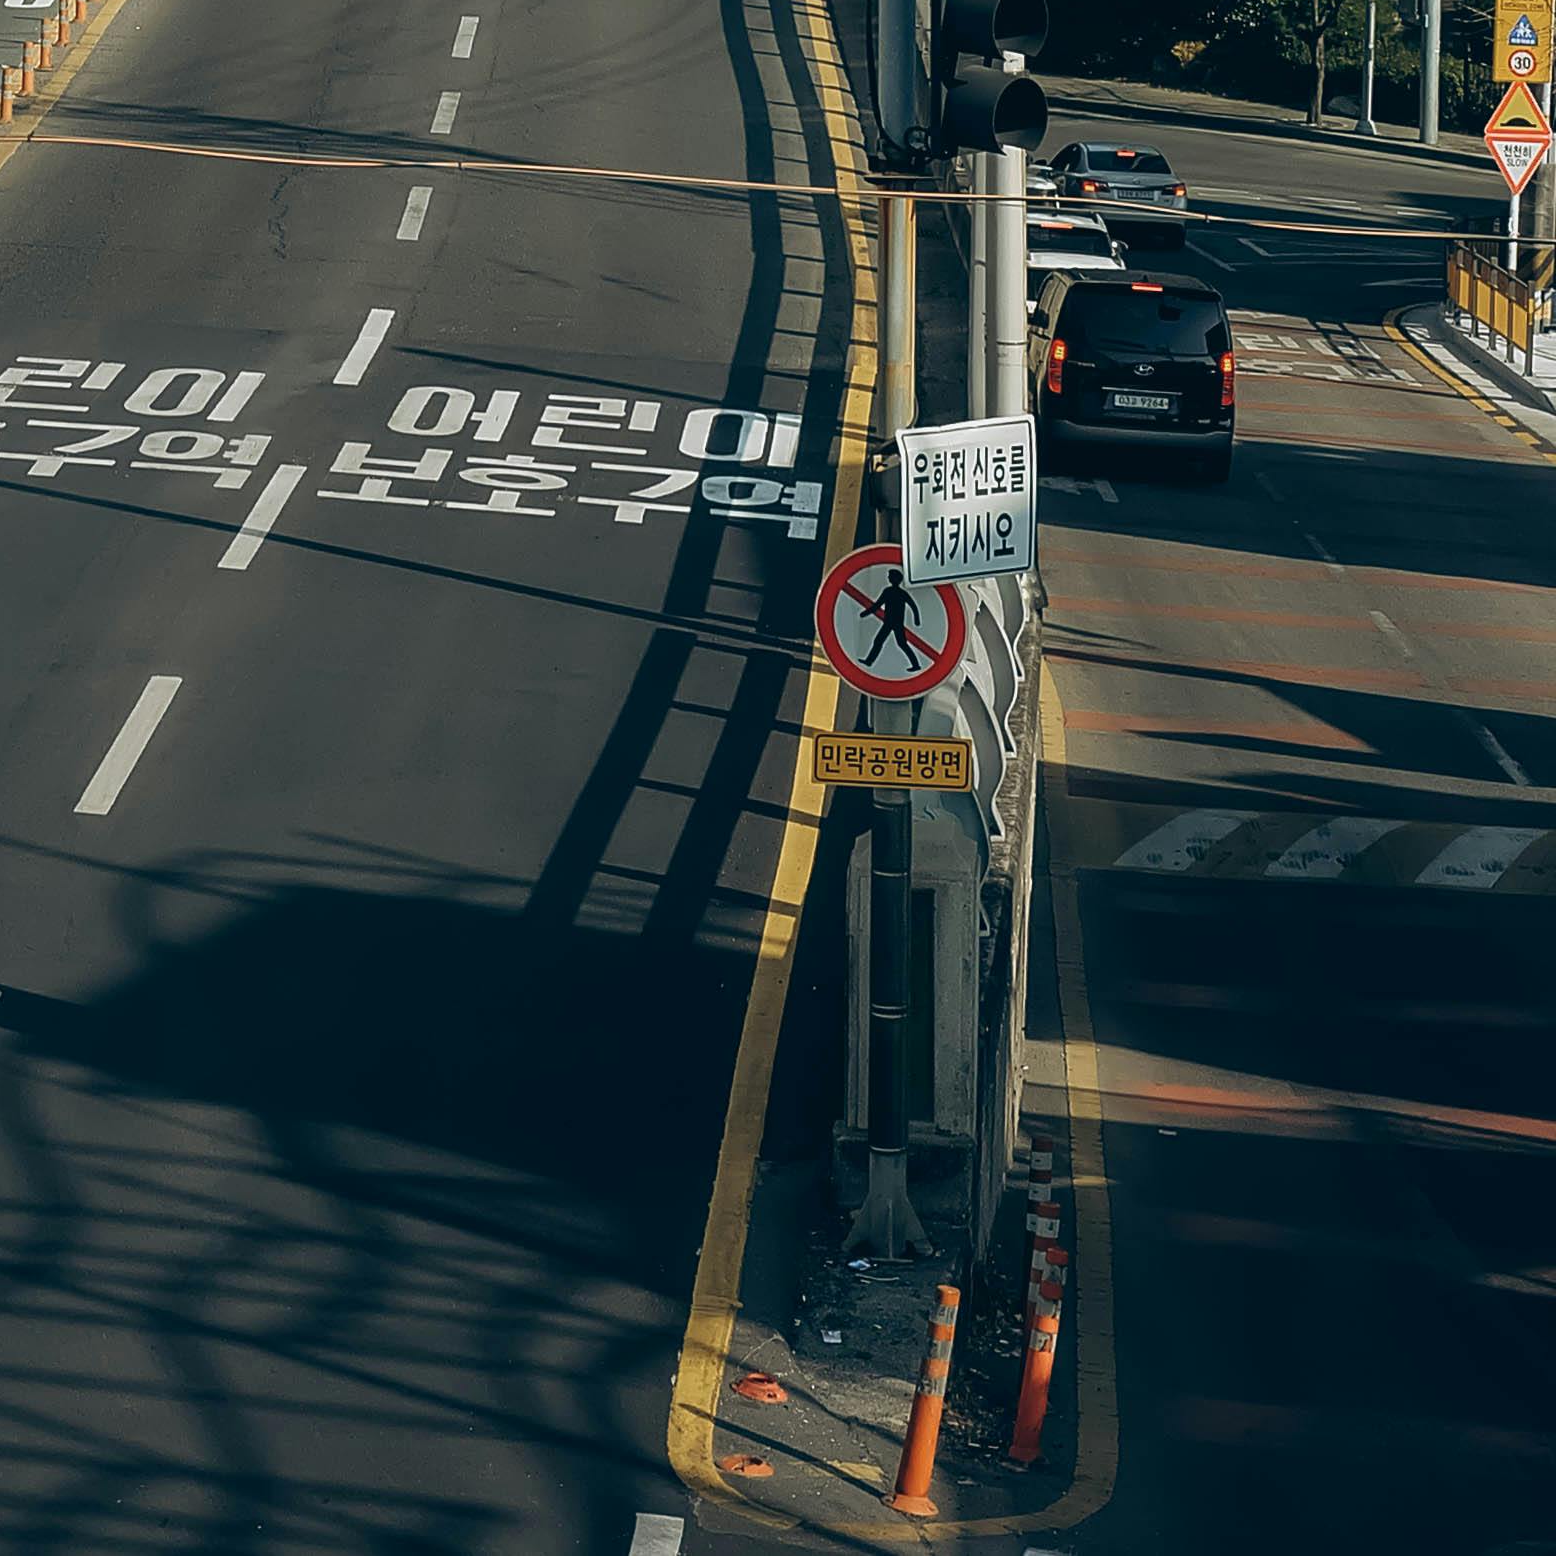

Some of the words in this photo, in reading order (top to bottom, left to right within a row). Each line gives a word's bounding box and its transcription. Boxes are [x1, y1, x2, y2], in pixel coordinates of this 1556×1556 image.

[1514, 56, 1531, 69] 30
[386, 384, 803, 466] 어린이
[316, 441, 823, 540] 보호구역
[912, 451, 968, 505] 우회전
[972, 444, 1026, 498] 신호를
[925, 512, 1015, 565] 지키시오
[821, 743, 962, 780] 민락공원방면
